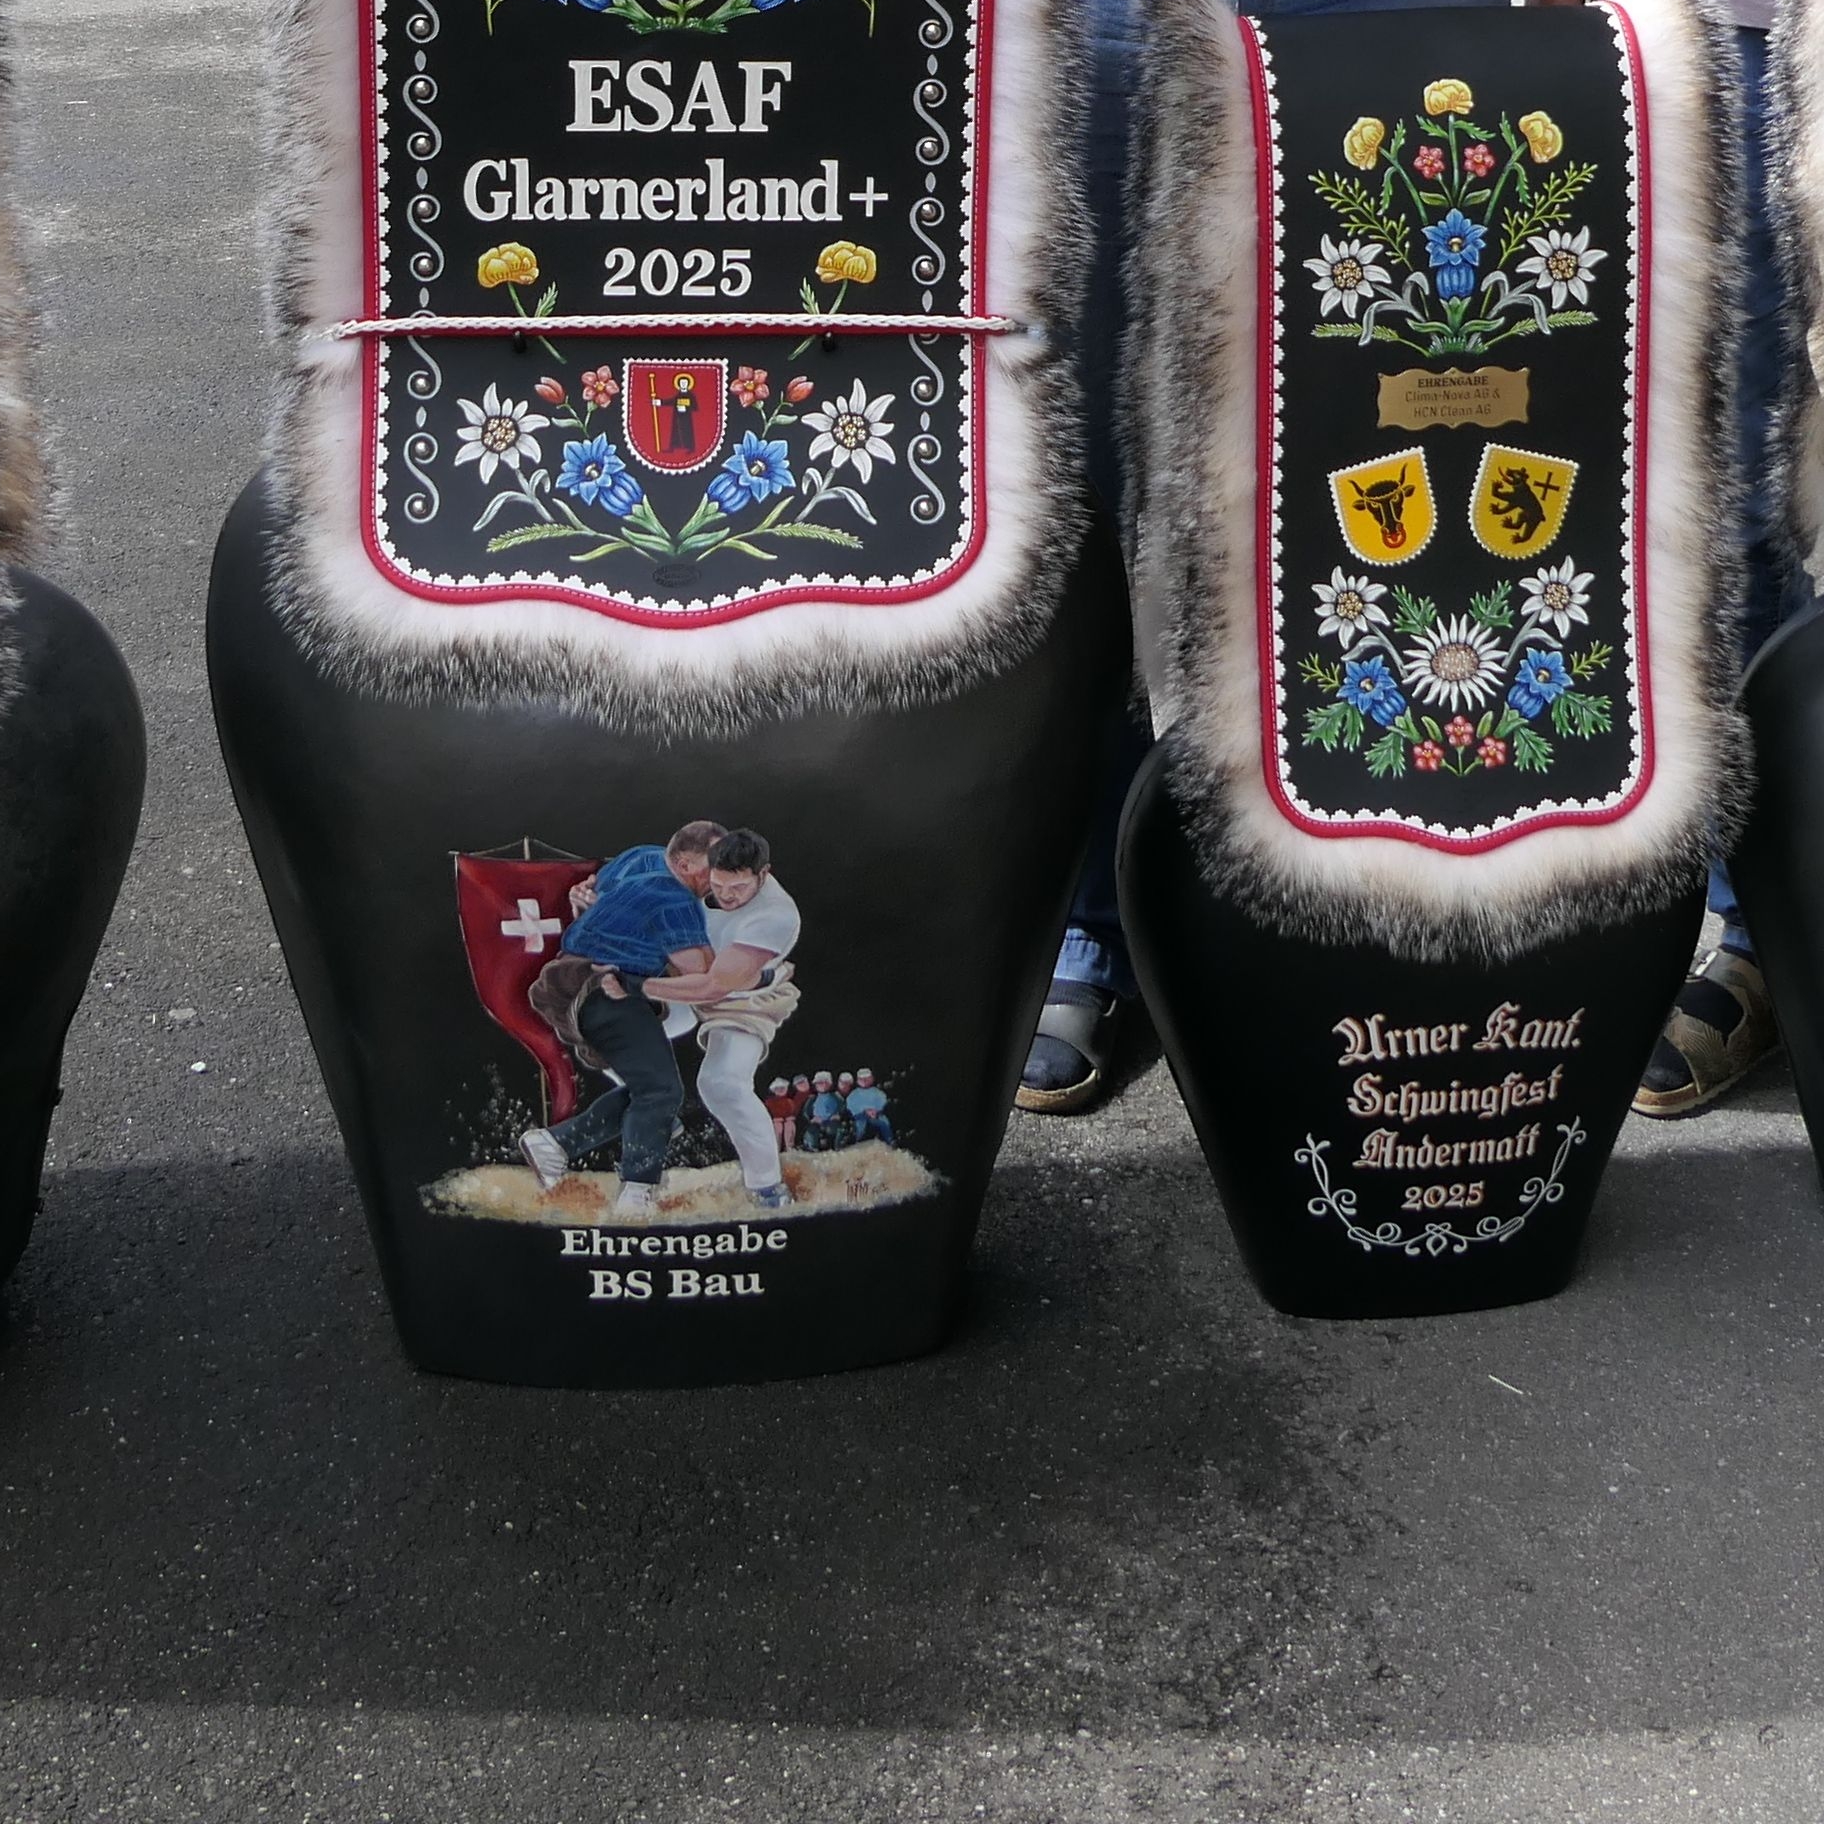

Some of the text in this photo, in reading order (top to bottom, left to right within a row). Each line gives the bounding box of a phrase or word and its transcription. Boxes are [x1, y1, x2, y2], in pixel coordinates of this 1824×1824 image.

[565, 59, 792, 133] ESAF
[602, 247, 753, 297] 2025
[1417, 375, 1489, 389] EHRENGABE
[1440, 405, 1472, 417] Clean
[1474, 404, 1492, 416] AG
[1331, 1001, 1585, 1066] Urner Kant.
[1346, 1063, 1564, 1123] Schwingfest
[1352, 1122, 1541, 1170] Andermatt
[1400, 1180, 1486, 1211] 2025
[559, 1223, 789, 1259] Ehrengabe
[588, 1266, 766, 1299] BS Bau
